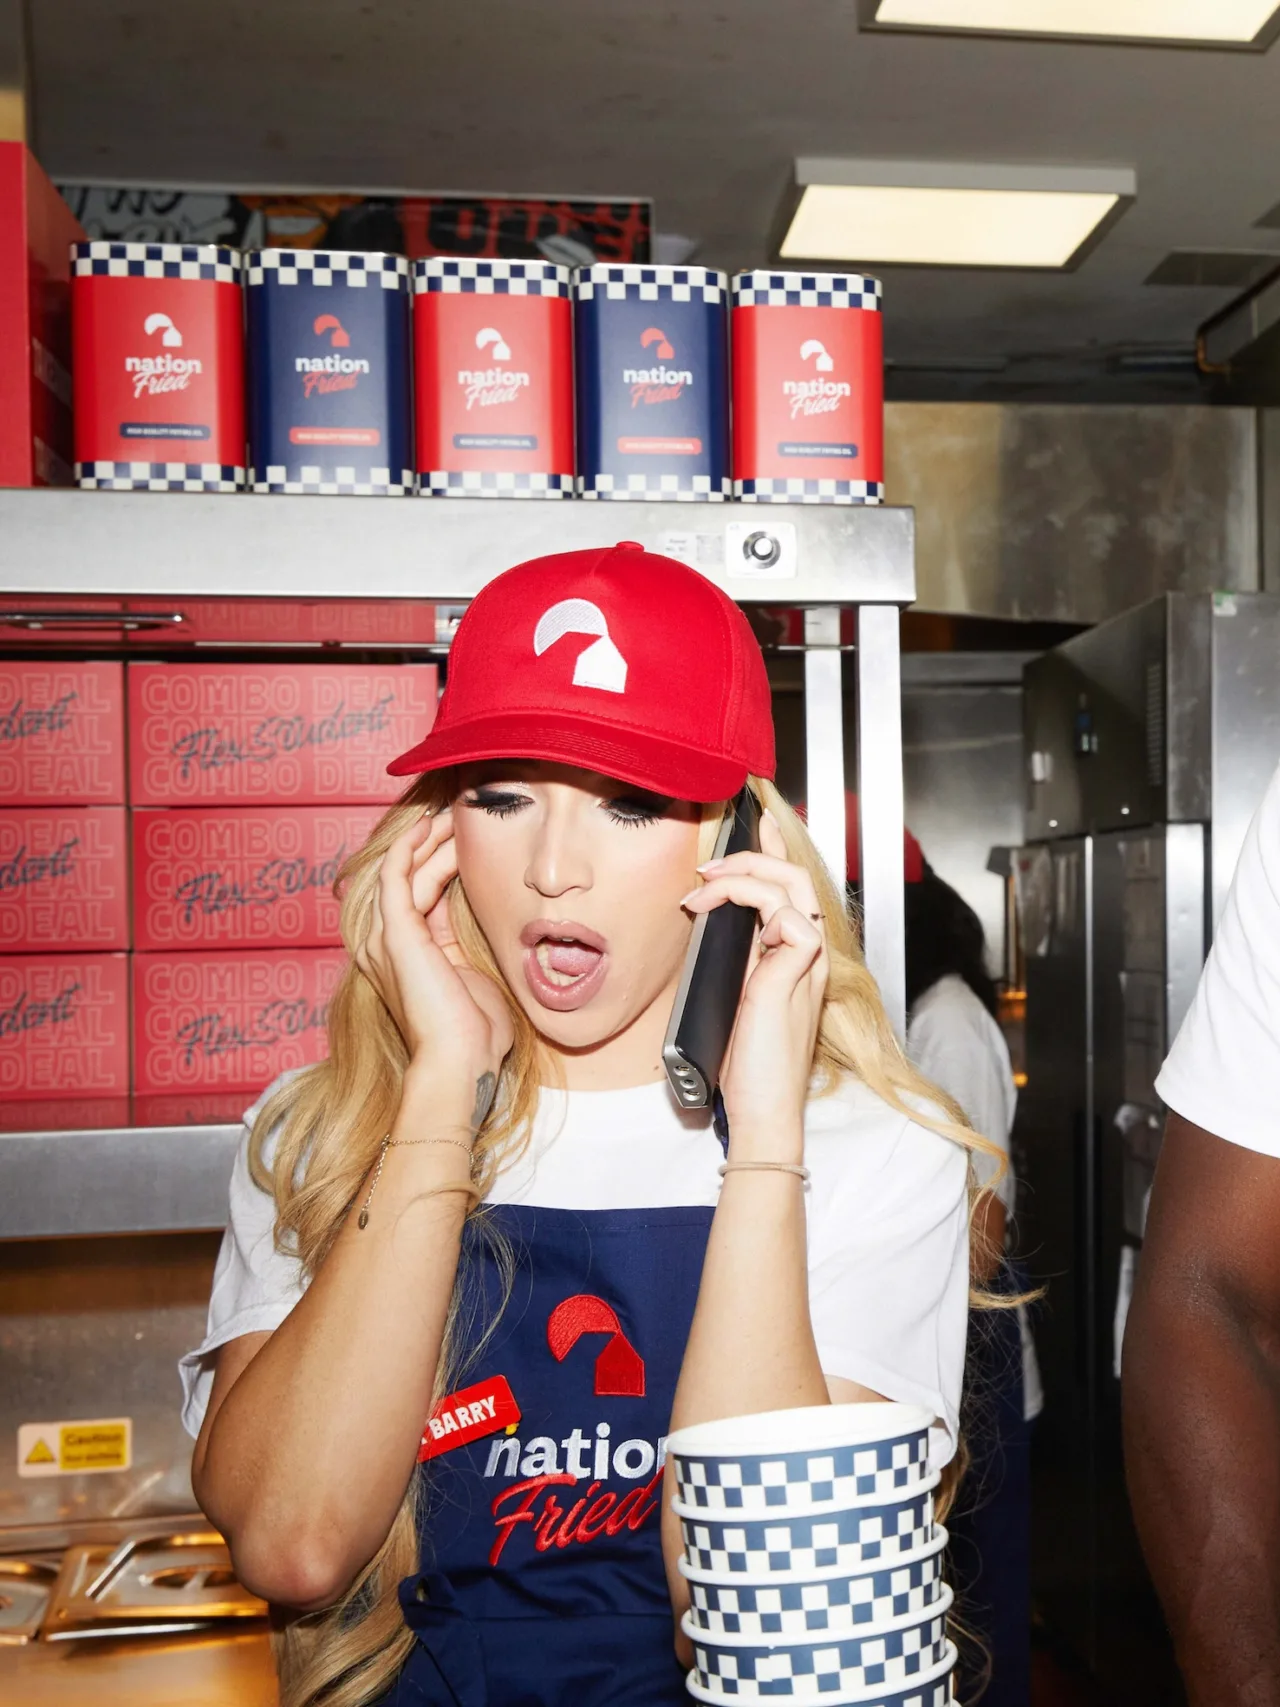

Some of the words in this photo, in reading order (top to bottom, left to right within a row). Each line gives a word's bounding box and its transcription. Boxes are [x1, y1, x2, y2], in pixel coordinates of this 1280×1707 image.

[125, 353, 203, 374] nation
[294, 354, 370, 374] nation
[457, 366, 530, 388] nation
[622, 364, 693, 386] nation
[132, 371, 193, 399] Fried
[464, 383, 519, 411] Fried
[782, 376, 852, 398] nation
[789, 393, 842, 420] Fried
[142, 674, 300, 714] COMBO
[313, 675, 427, 714] DEAL
[142, 715, 301, 756] COMBO
[142, 755, 301, 797] COMBO
[314, 756, 403, 796] DEA
[145, 818, 302, 860] COMBO
[145, 859, 303, 901] COMBO
[146, 899, 304, 942] COMBO
[144, 960, 303, 1003] COMBO
[145, 1002, 304, 1046] COMBO
[428, 1395, 498, 1440] BARRY
[489, 1463, 666, 1567] Fried
